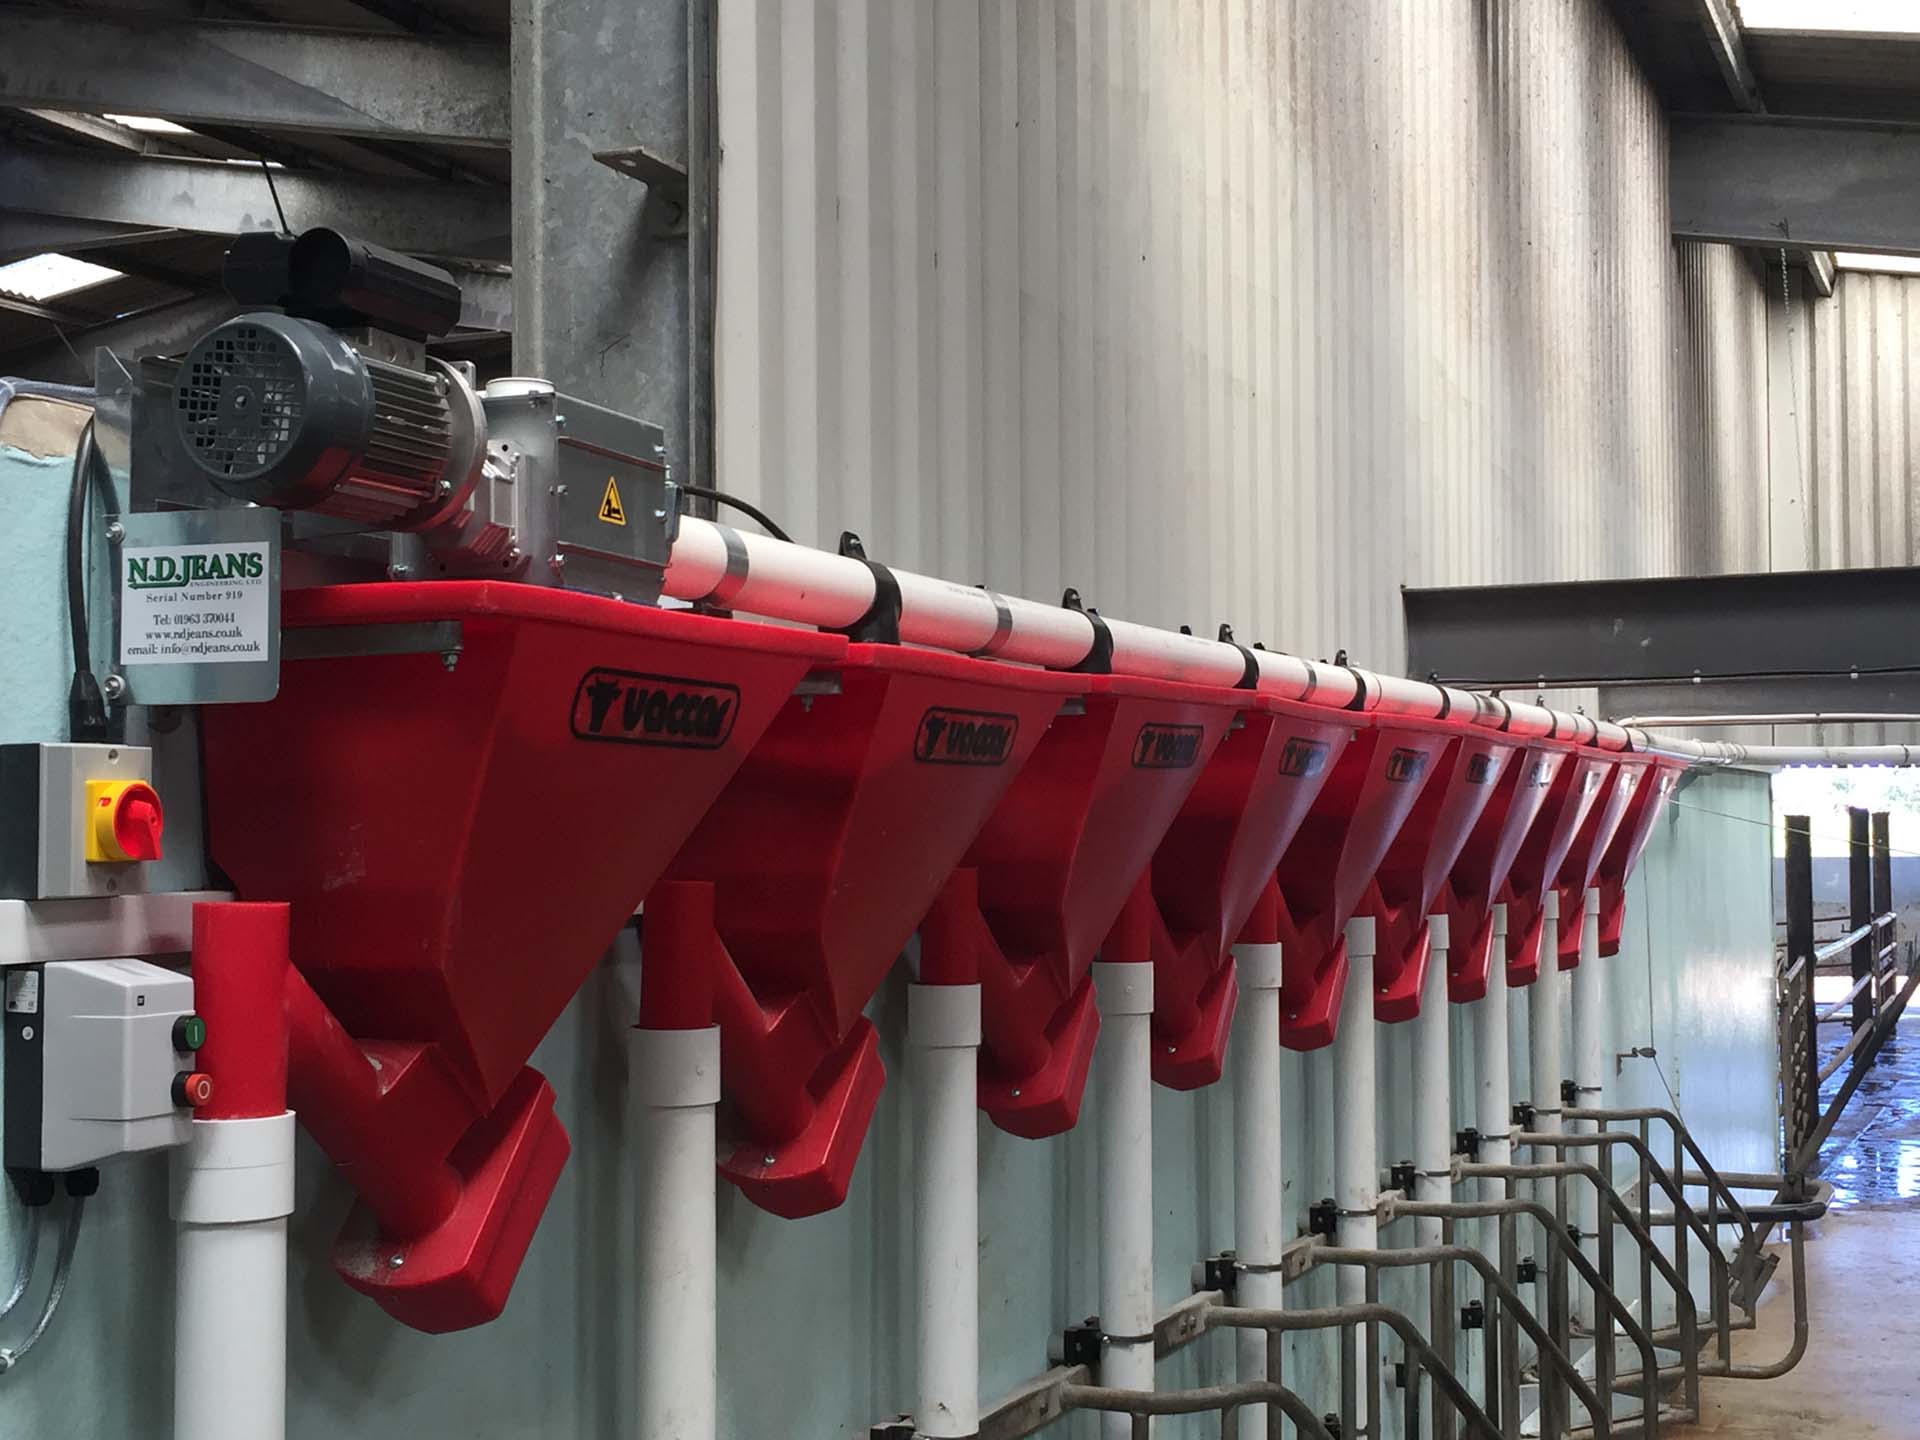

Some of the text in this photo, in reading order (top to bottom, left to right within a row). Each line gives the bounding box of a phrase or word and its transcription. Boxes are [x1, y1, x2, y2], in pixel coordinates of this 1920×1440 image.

[190, 580, 243, 588] ENGINEERING
[146, 593, 177, 603] Serial
[181, 591, 222, 602] Number
[153, 614, 171, 626] Tel:
[145, 626, 243, 641] www.ndjeans.co.uk
[127, 641, 260, 655] email: info@ndjeans.co.uk
